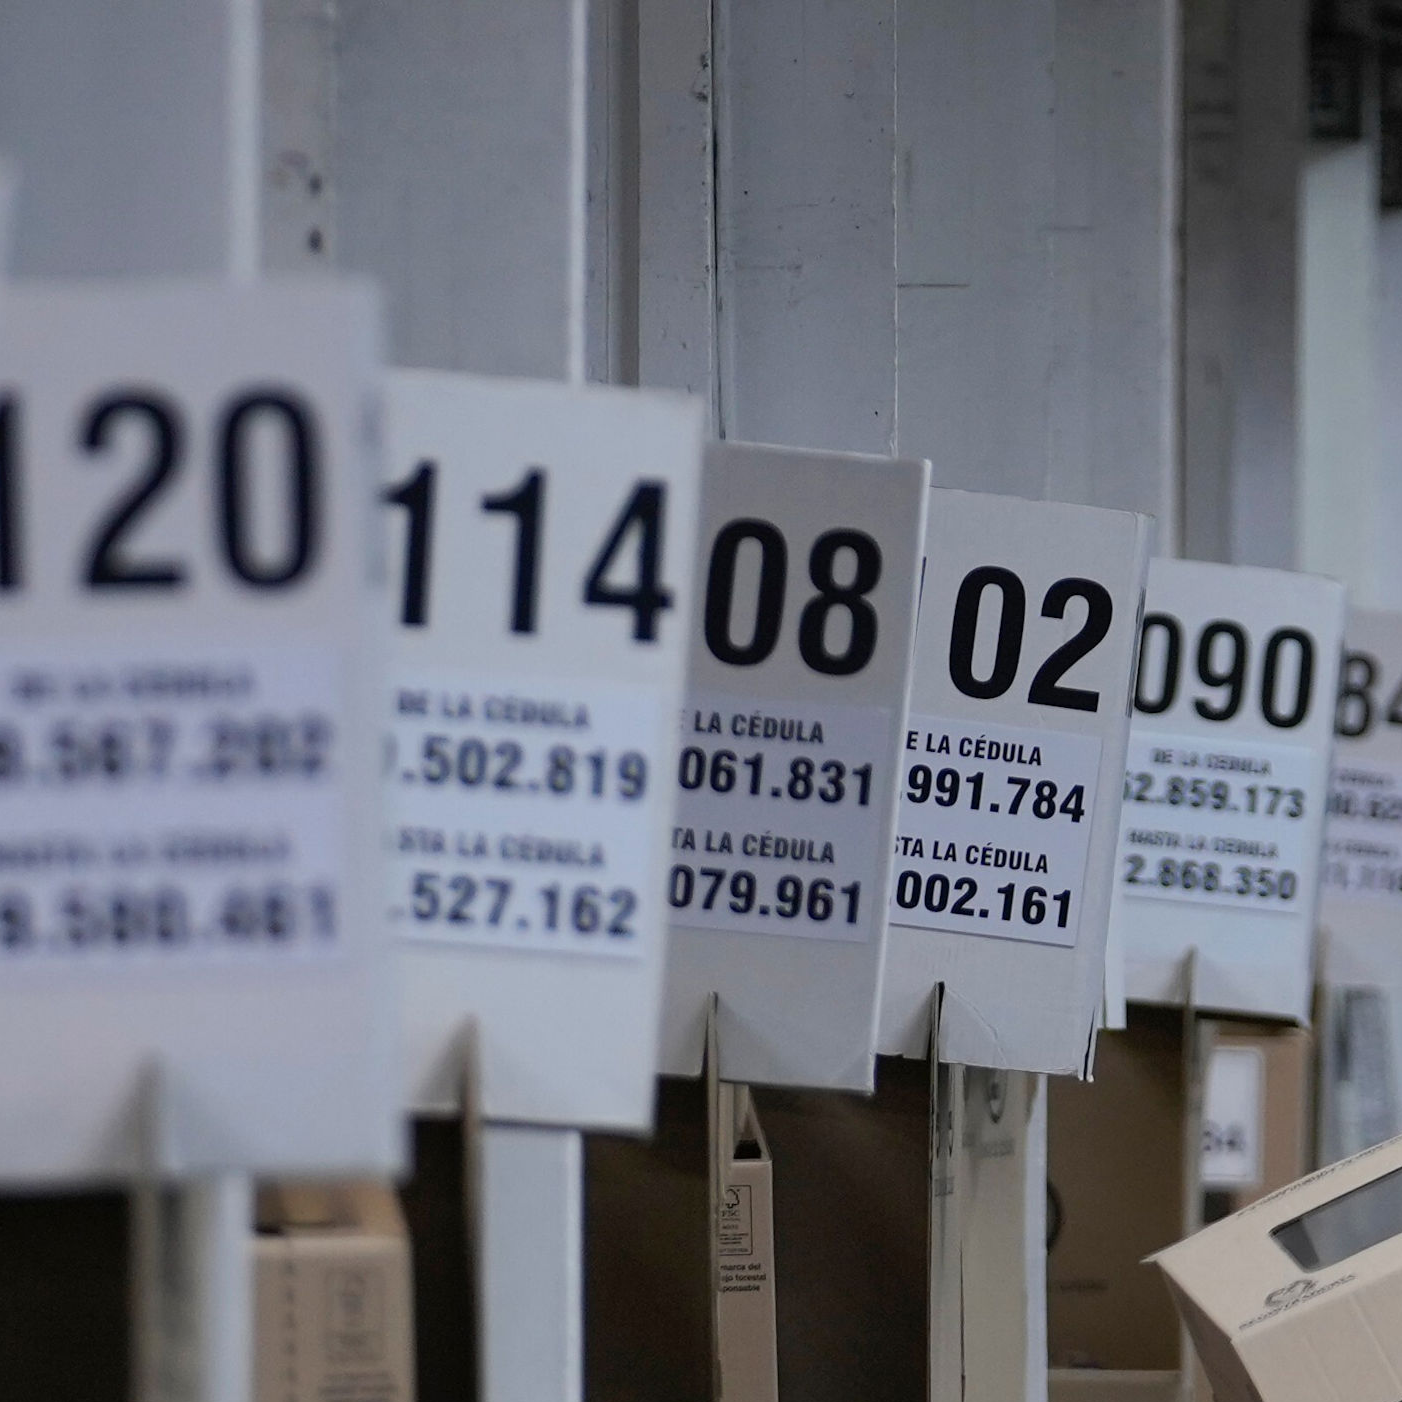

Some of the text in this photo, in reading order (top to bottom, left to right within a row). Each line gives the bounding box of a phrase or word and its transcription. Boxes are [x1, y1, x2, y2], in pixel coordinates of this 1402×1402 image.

[382, 460, 675, 641] 114
[919, 556, 1113, 713] 02
[1134, 612, 1314, 728] 090
[694, 710, 824, 743] LA CÉDULA
[926, 733, 951, 755] LA
[959, 734, 1043, 766] CÉDULA
[382, 733, 647, 801] .502.819
[678, 745, 874, 806] 061.831
[900, 764, 1085, 823] 991.784
[705, 830, 733, 853] LA
[742, 830, 835, 863] CÉDULA
[895, 836, 1049, 874] TA LA CÉDULA
[668, 863, 862, 924] 079.961
[896, 869, 1071, 928] 002.161
